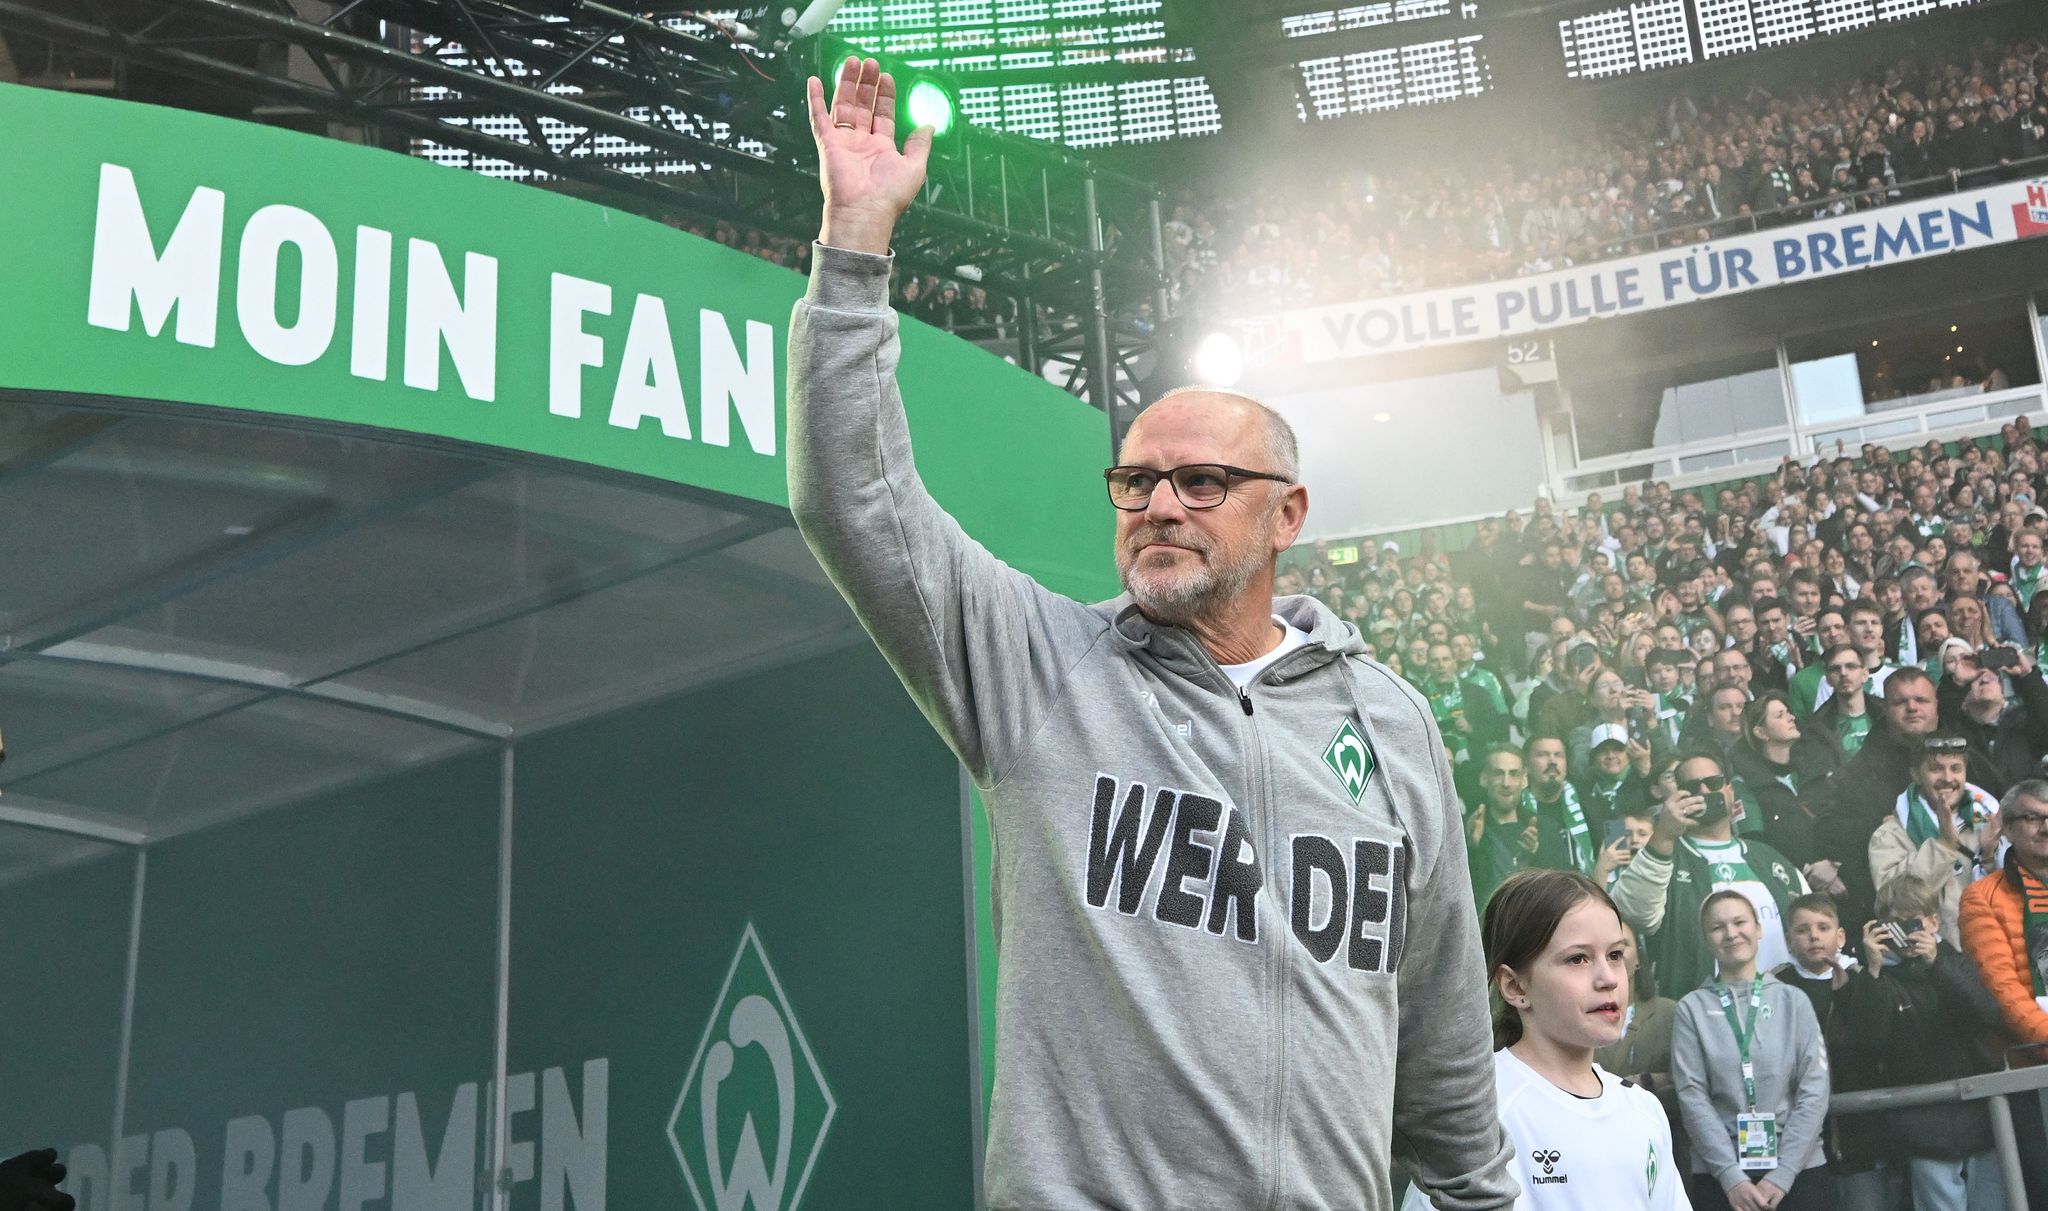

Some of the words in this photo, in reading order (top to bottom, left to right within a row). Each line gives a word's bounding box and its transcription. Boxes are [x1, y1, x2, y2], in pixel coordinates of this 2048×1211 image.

[87, 162, 498, 402] MOIN
[549, 271, 777, 456] FAN
[1322, 296, 1480, 351] VOLLE
[1495, 267, 1644, 330] PULLE
[1660, 244, 1759, 300] FÜR
[1773, 200, 1993, 279] BREMEN
[1507, 341, 1540, 364] 52
[220, 1057, 609, 1211] BREMEN
[1532, 1174, 1568, 1185] hummel
